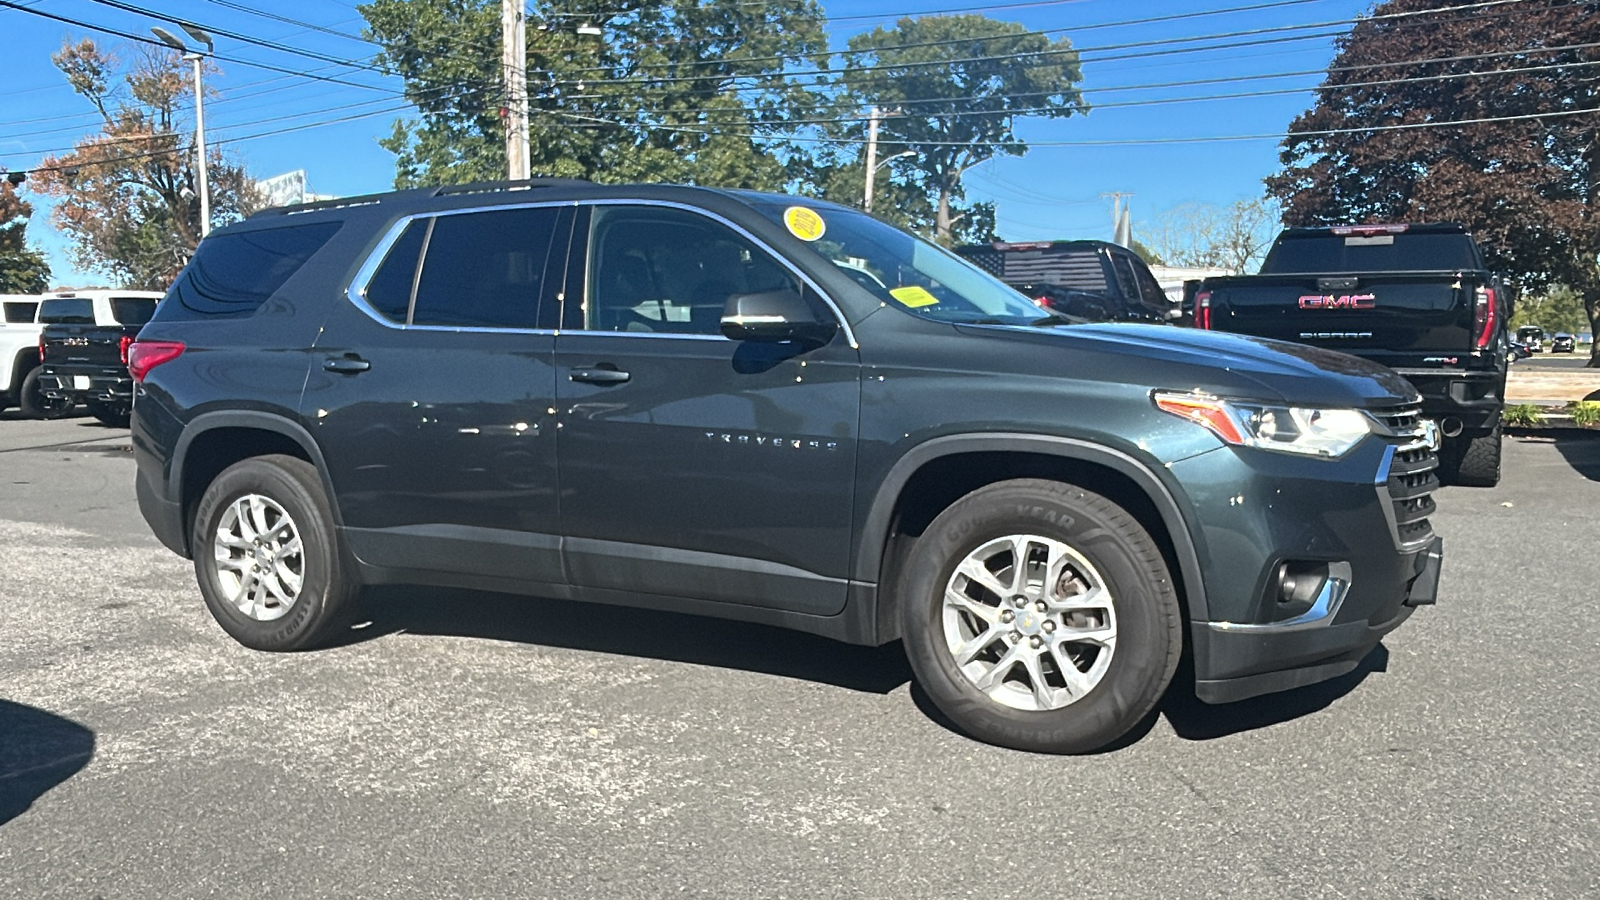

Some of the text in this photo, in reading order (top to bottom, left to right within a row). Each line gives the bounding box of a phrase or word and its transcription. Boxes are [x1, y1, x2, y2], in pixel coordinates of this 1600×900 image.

[1299, 293, 1375, 309] GMC
[1300, 331, 1373, 339] SIERRA
[705, 431, 837, 450] TRAVERSE
[1016, 503, 1076, 529] YEAR
